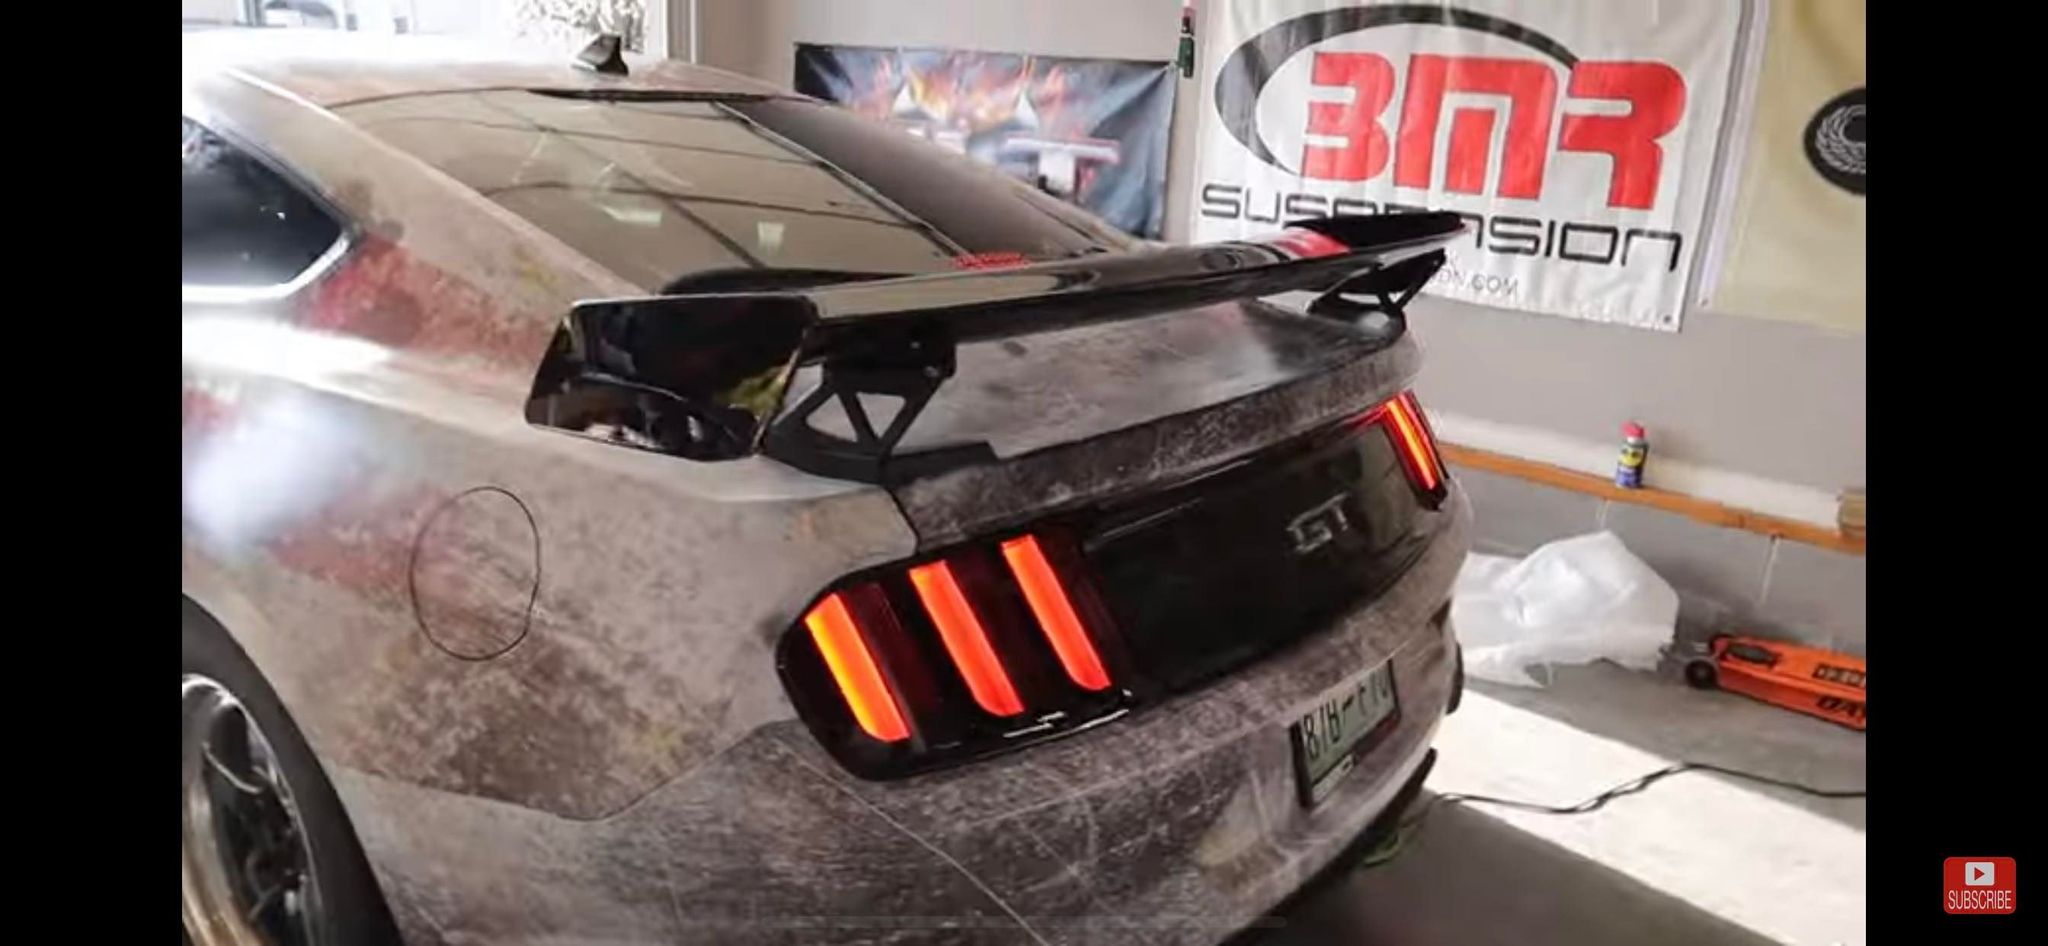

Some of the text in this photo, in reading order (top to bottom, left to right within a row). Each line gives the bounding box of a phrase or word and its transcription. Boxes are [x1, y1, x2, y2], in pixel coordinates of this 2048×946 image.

[1300, 51, 1688, 211] BMR
[1200, 184, 1683, 271] SUSPNSION
[1286, 493, 1350, 552] GT
